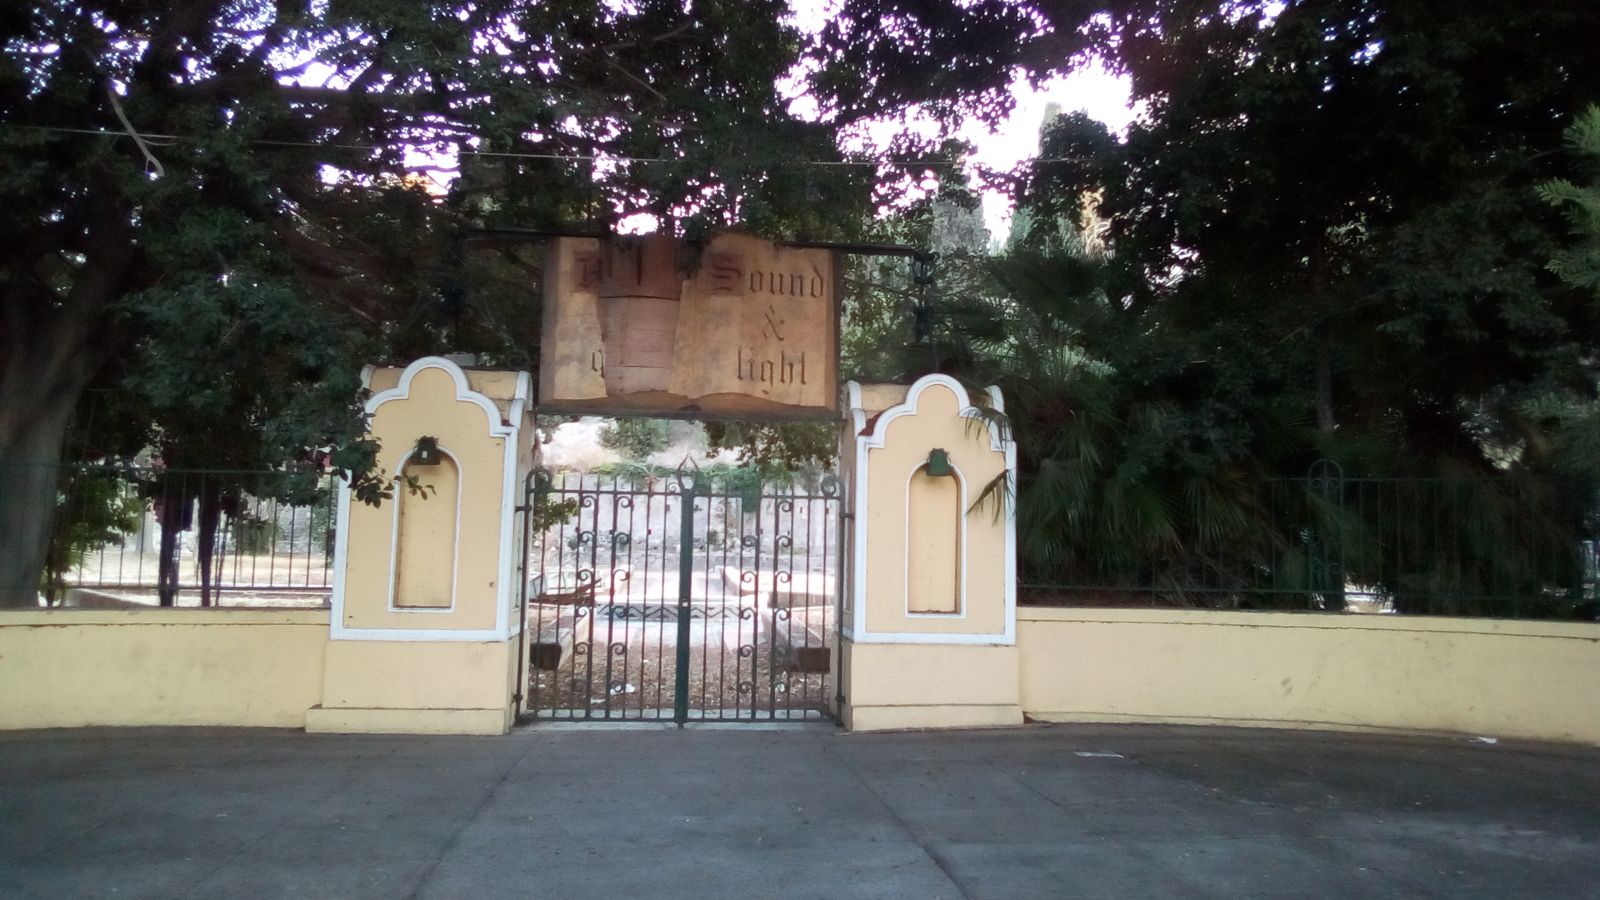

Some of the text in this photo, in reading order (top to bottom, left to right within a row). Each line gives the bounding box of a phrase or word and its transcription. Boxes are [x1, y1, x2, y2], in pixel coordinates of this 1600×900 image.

[711, 254, 824, 298] Sound
[762, 304, 785, 341] &
[737, 345, 808, 395] light
